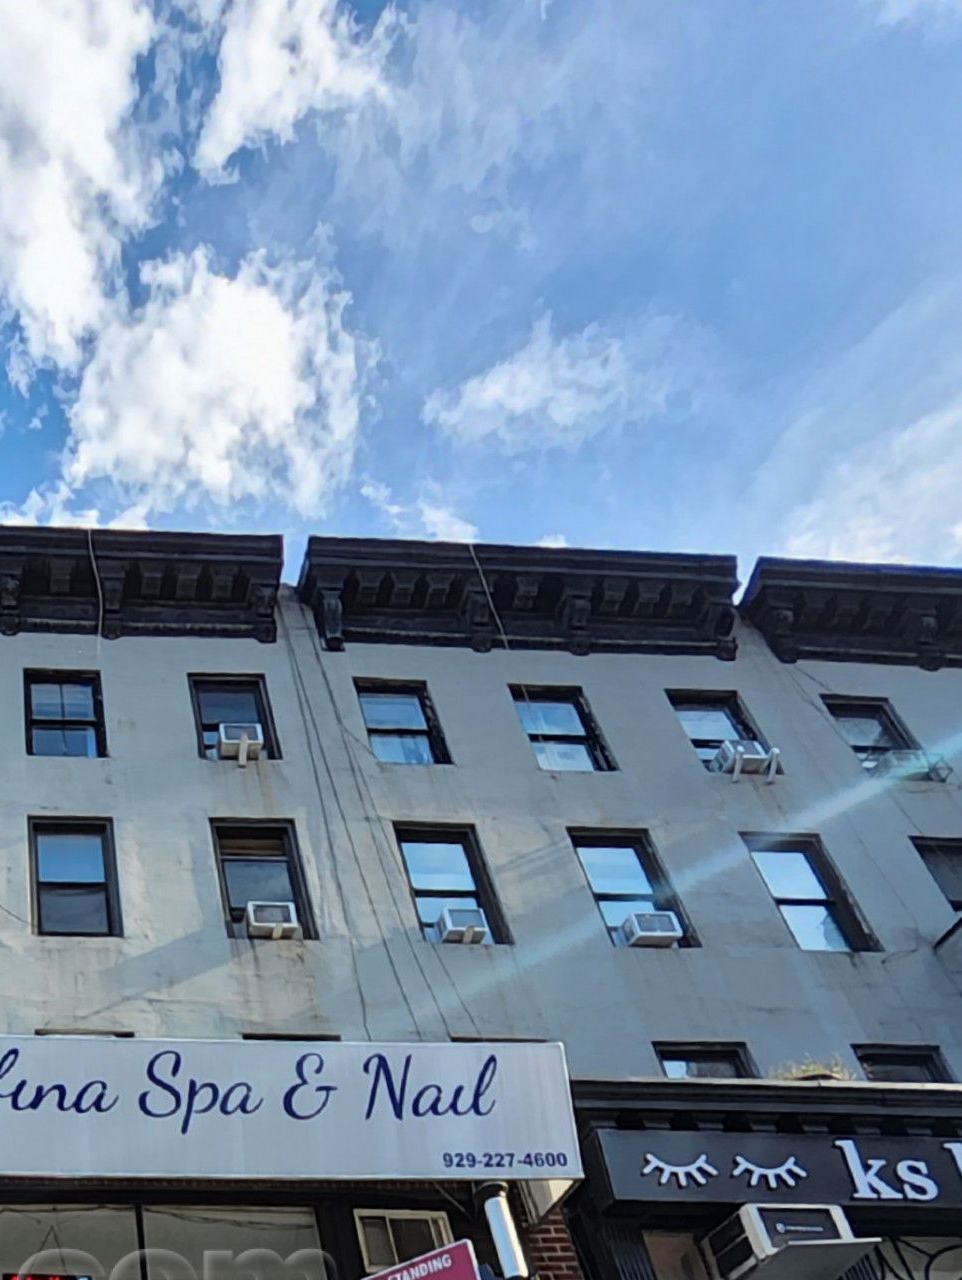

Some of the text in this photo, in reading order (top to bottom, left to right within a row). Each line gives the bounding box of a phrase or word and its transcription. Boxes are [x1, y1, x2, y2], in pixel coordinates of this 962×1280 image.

[138, 1050, 263, 1135] Spa
[282, 1052, 337, 1120] &
[361, 1053, 498, 1121] Nail
[442, 1151, 569, 1168] 929-227-4600
[835, 1140, 938, 1201] ks
